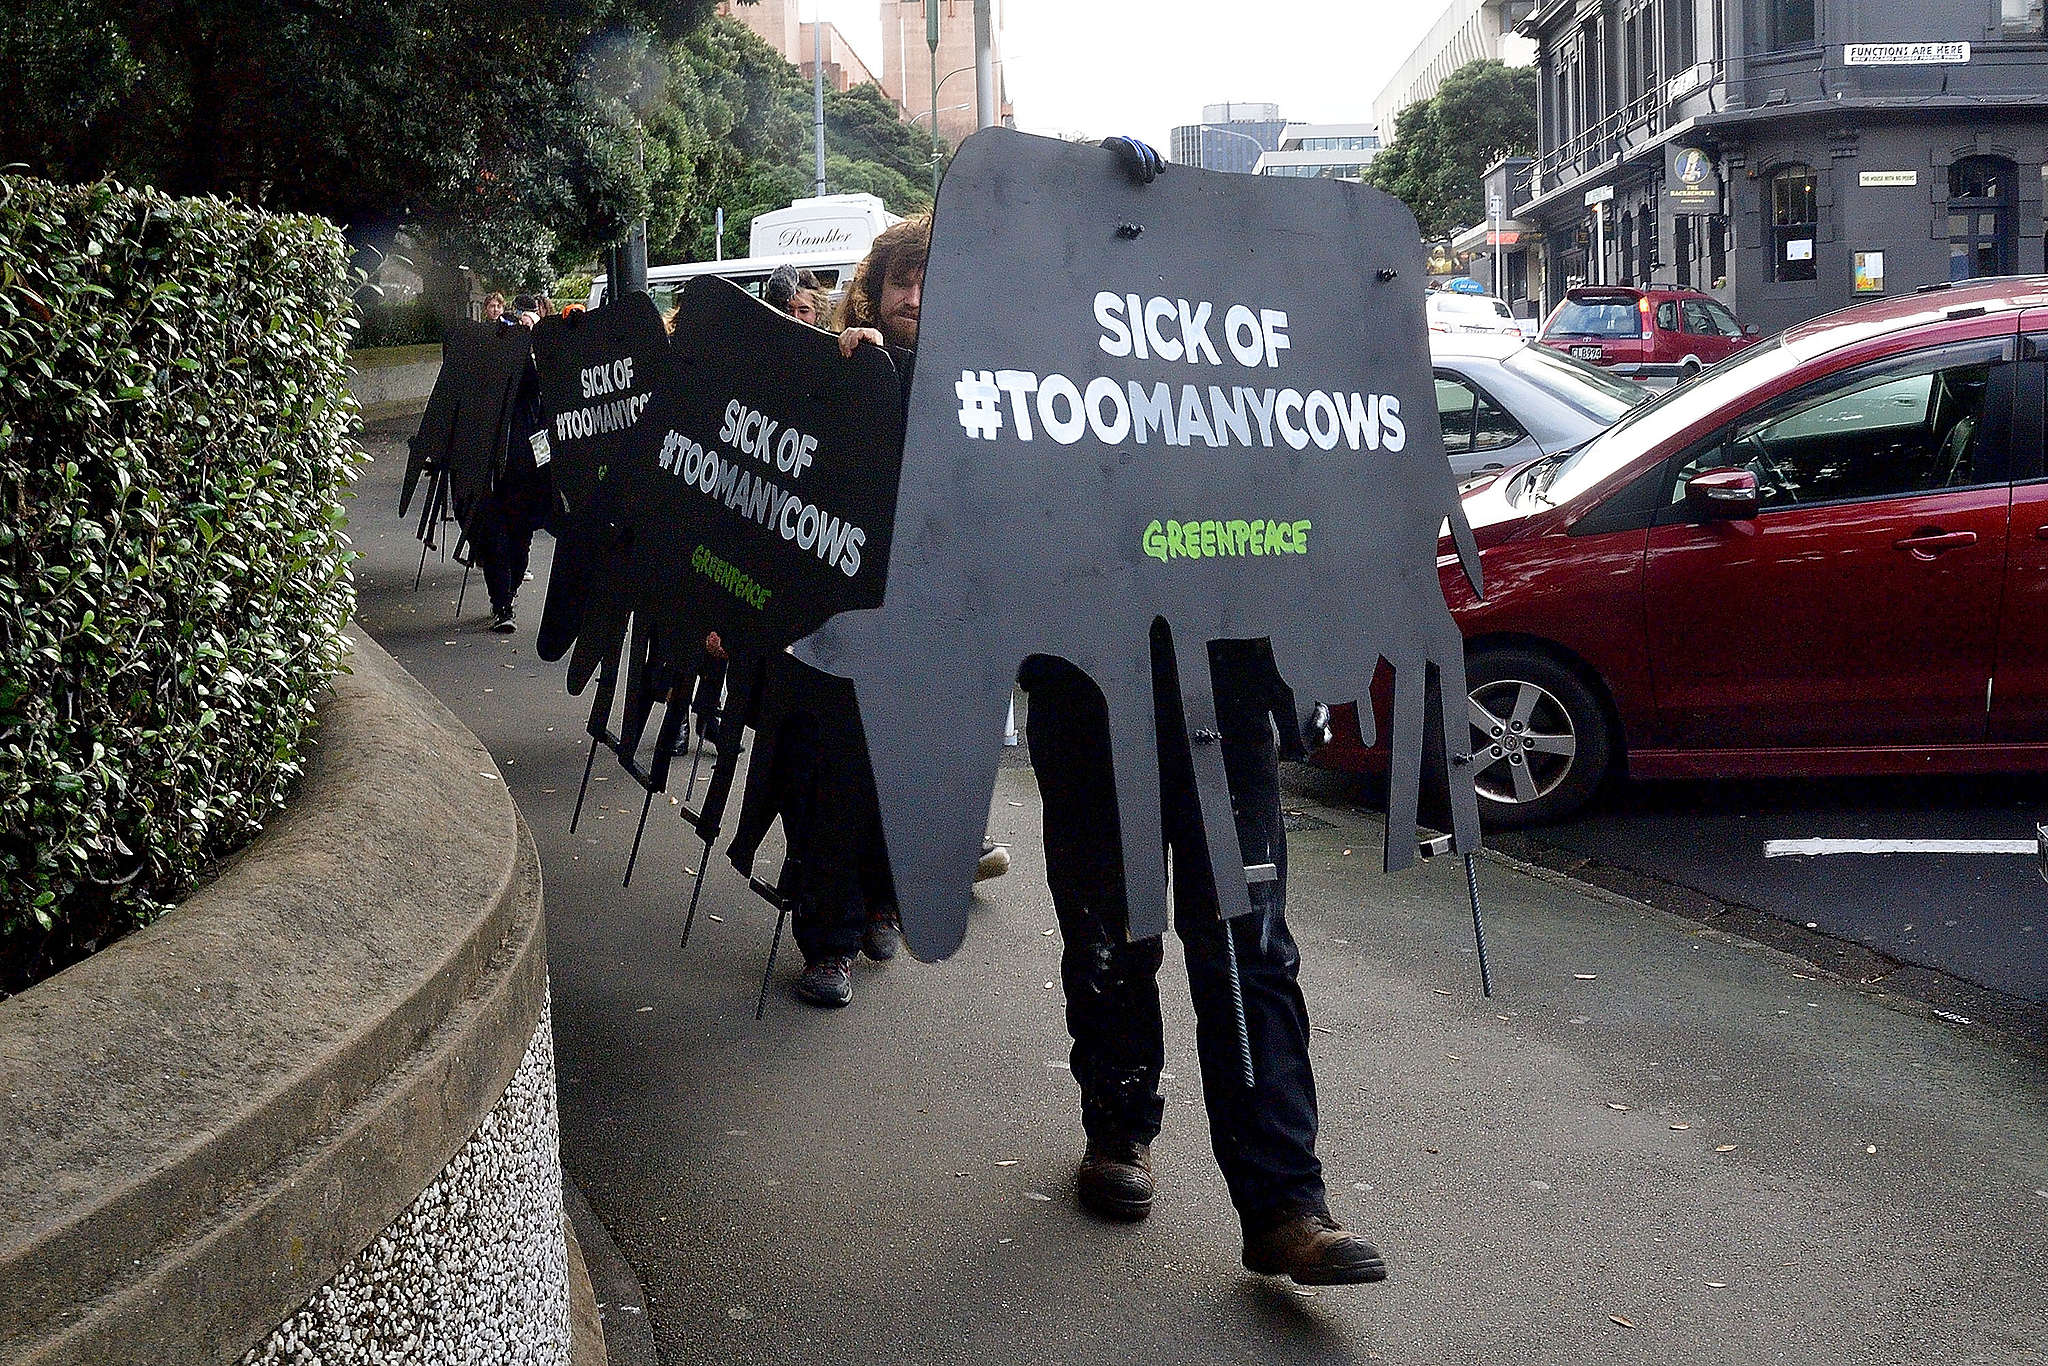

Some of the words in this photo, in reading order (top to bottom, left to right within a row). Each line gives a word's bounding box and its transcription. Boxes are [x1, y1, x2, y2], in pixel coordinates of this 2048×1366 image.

[1850, 46, 1908, 56] FUNCTIONS
[1912, 46, 1932, 55] ARE
[1936, 44, 1963, 54] HERE
[778, 227, 852, 248] Rambler
[1093, 291, 1222, 366] SICK
[1224, 304, 1291, 368] OF
[581, 368, 614, 399] SICK
[613, 357, 634, 390] OF
[954, 369, 1407, 452] #TOOMANYCOWS
[719, 399, 779, 464] SICK
[776, 428, 818, 478] OF
[659, 429, 866, 577] #TOOMANYCOWS
[1142, 519, 1312, 563] GREENPEACE
[691, 544, 772, 611] GREENPEACE
